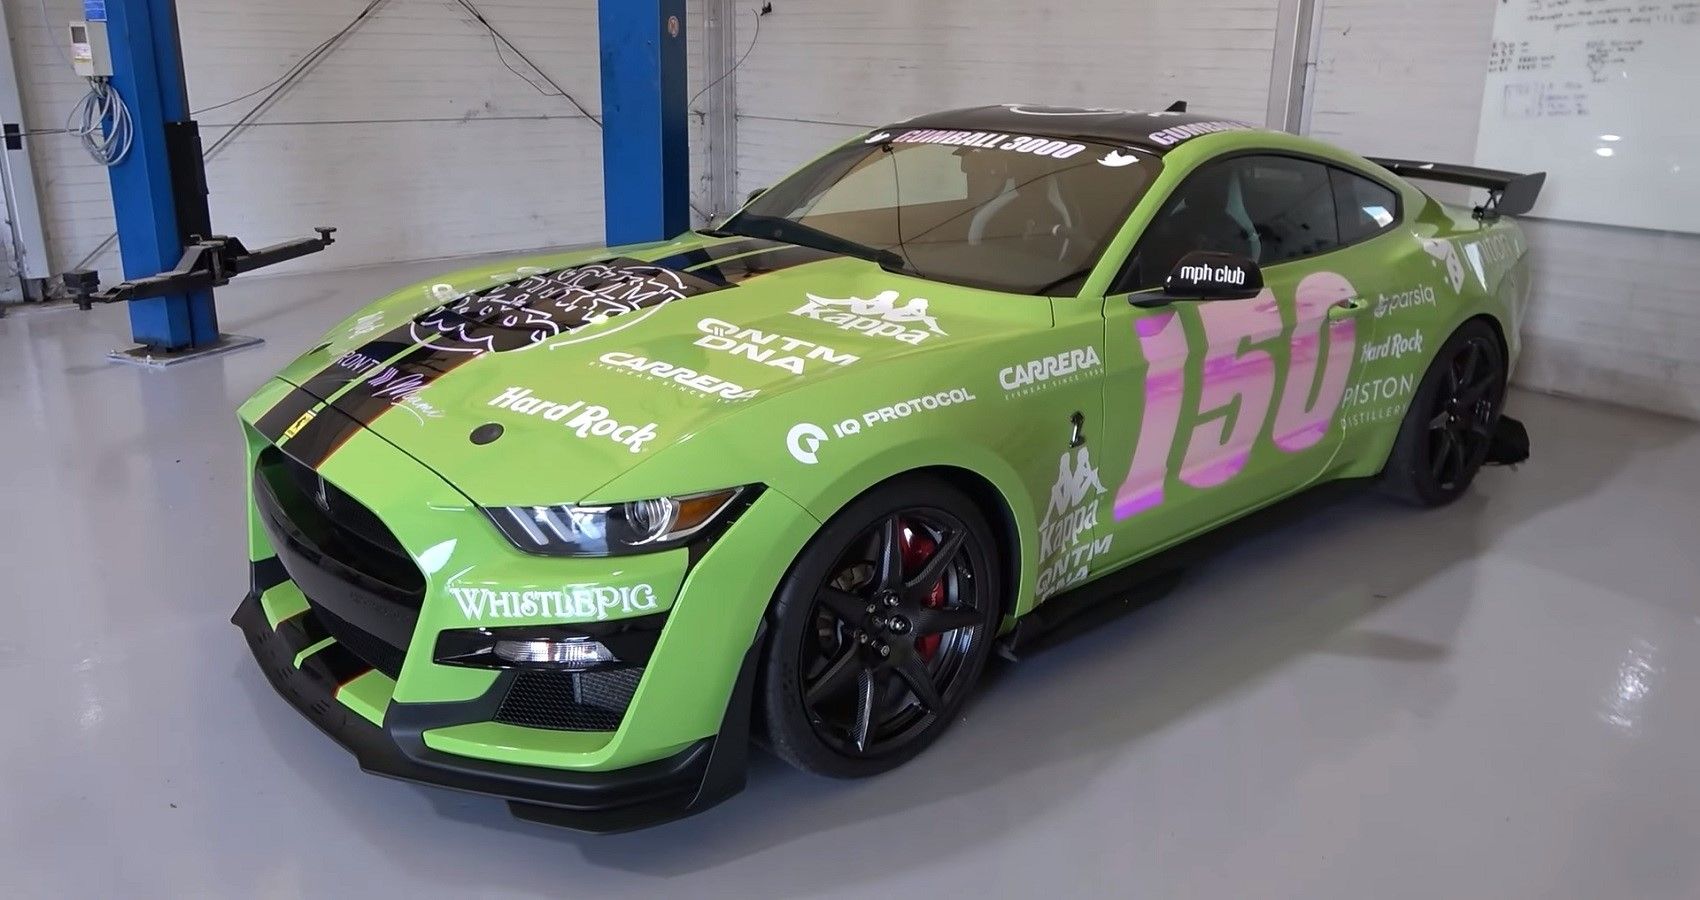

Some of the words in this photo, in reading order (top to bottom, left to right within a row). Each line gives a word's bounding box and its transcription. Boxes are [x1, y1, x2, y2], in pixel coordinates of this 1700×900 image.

[892, 129, 1010, 149] GUMBALL
[999, 136, 1087, 159] 3000
[1180, 263, 1213, 285] mph
[1215, 265, 1246, 285] club
[1388, 283, 1437, 316] parsiq
[696, 317, 862, 366] QNTM
[788, 301, 933, 346] Kappa
[1360, 336, 1391, 363] Hard
[1391, 328, 1423, 359] Rock
[599, 351, 762, 400] CARRERA
[692, 334, 807, 375] DNA
[999, 345, 1101, 391] CARRERA
[832, 419, 861, 438] IQ
[862, 387, 977, 427] PROTOCOL
[1112, 271, 1358, 522] 150
[1341, 373, 1414, 409] PISTON
[487, 386, 587, 422] Hard
[564, 404, 659, 454] Rock
[1039, 499, 1099, 566] Kappa
